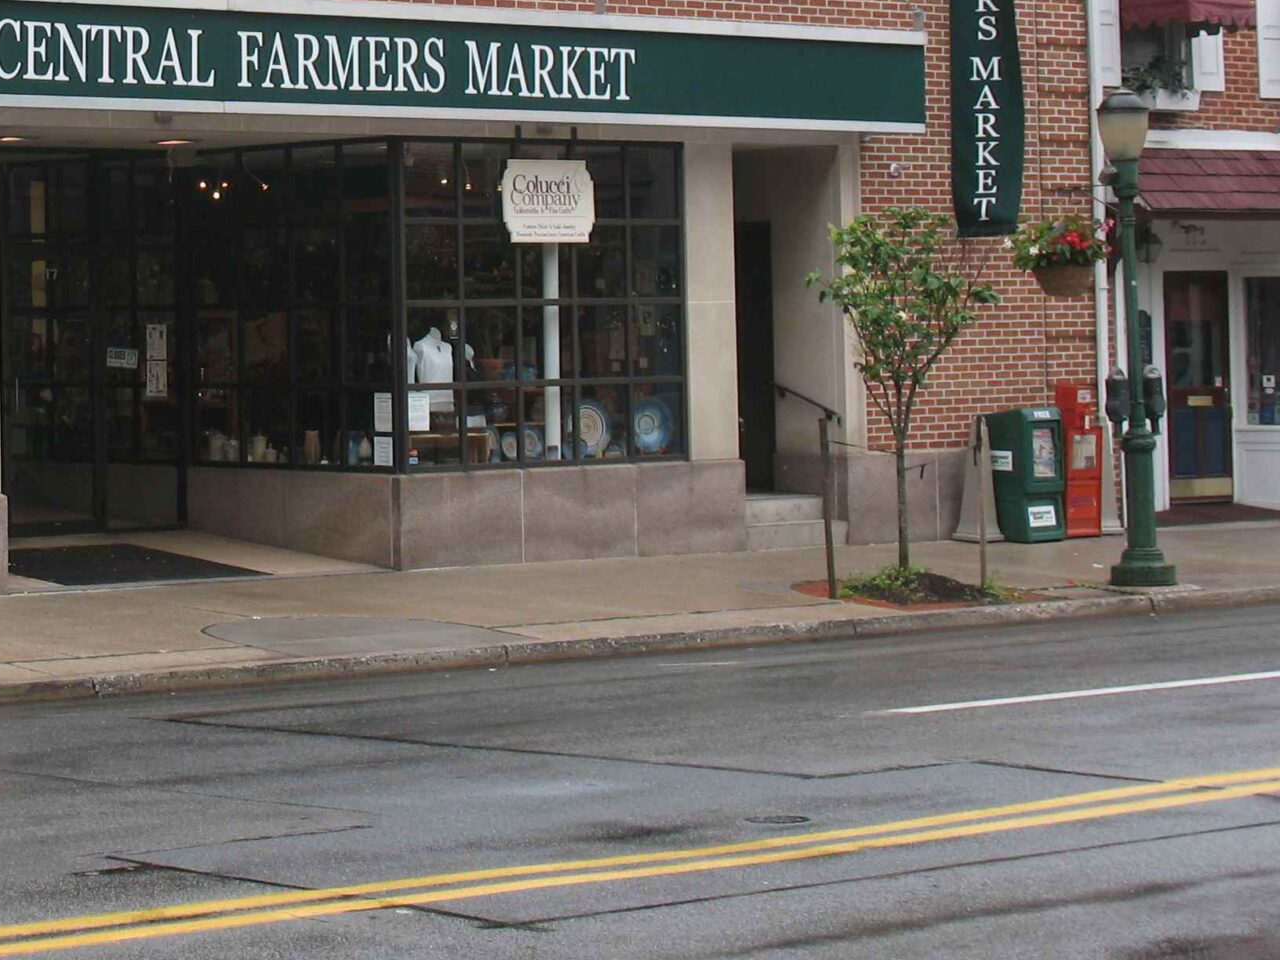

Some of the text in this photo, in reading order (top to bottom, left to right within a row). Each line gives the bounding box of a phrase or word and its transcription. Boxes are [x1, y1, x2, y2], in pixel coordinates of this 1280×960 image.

[236, 30, 446, 94] FARMERS
[464, 39, 637, 101] MARKET
[969, 56, 1003, 222] MARKET
[510, 190, 581, 211] Company
[512, 174, 571, 194] Colucci
